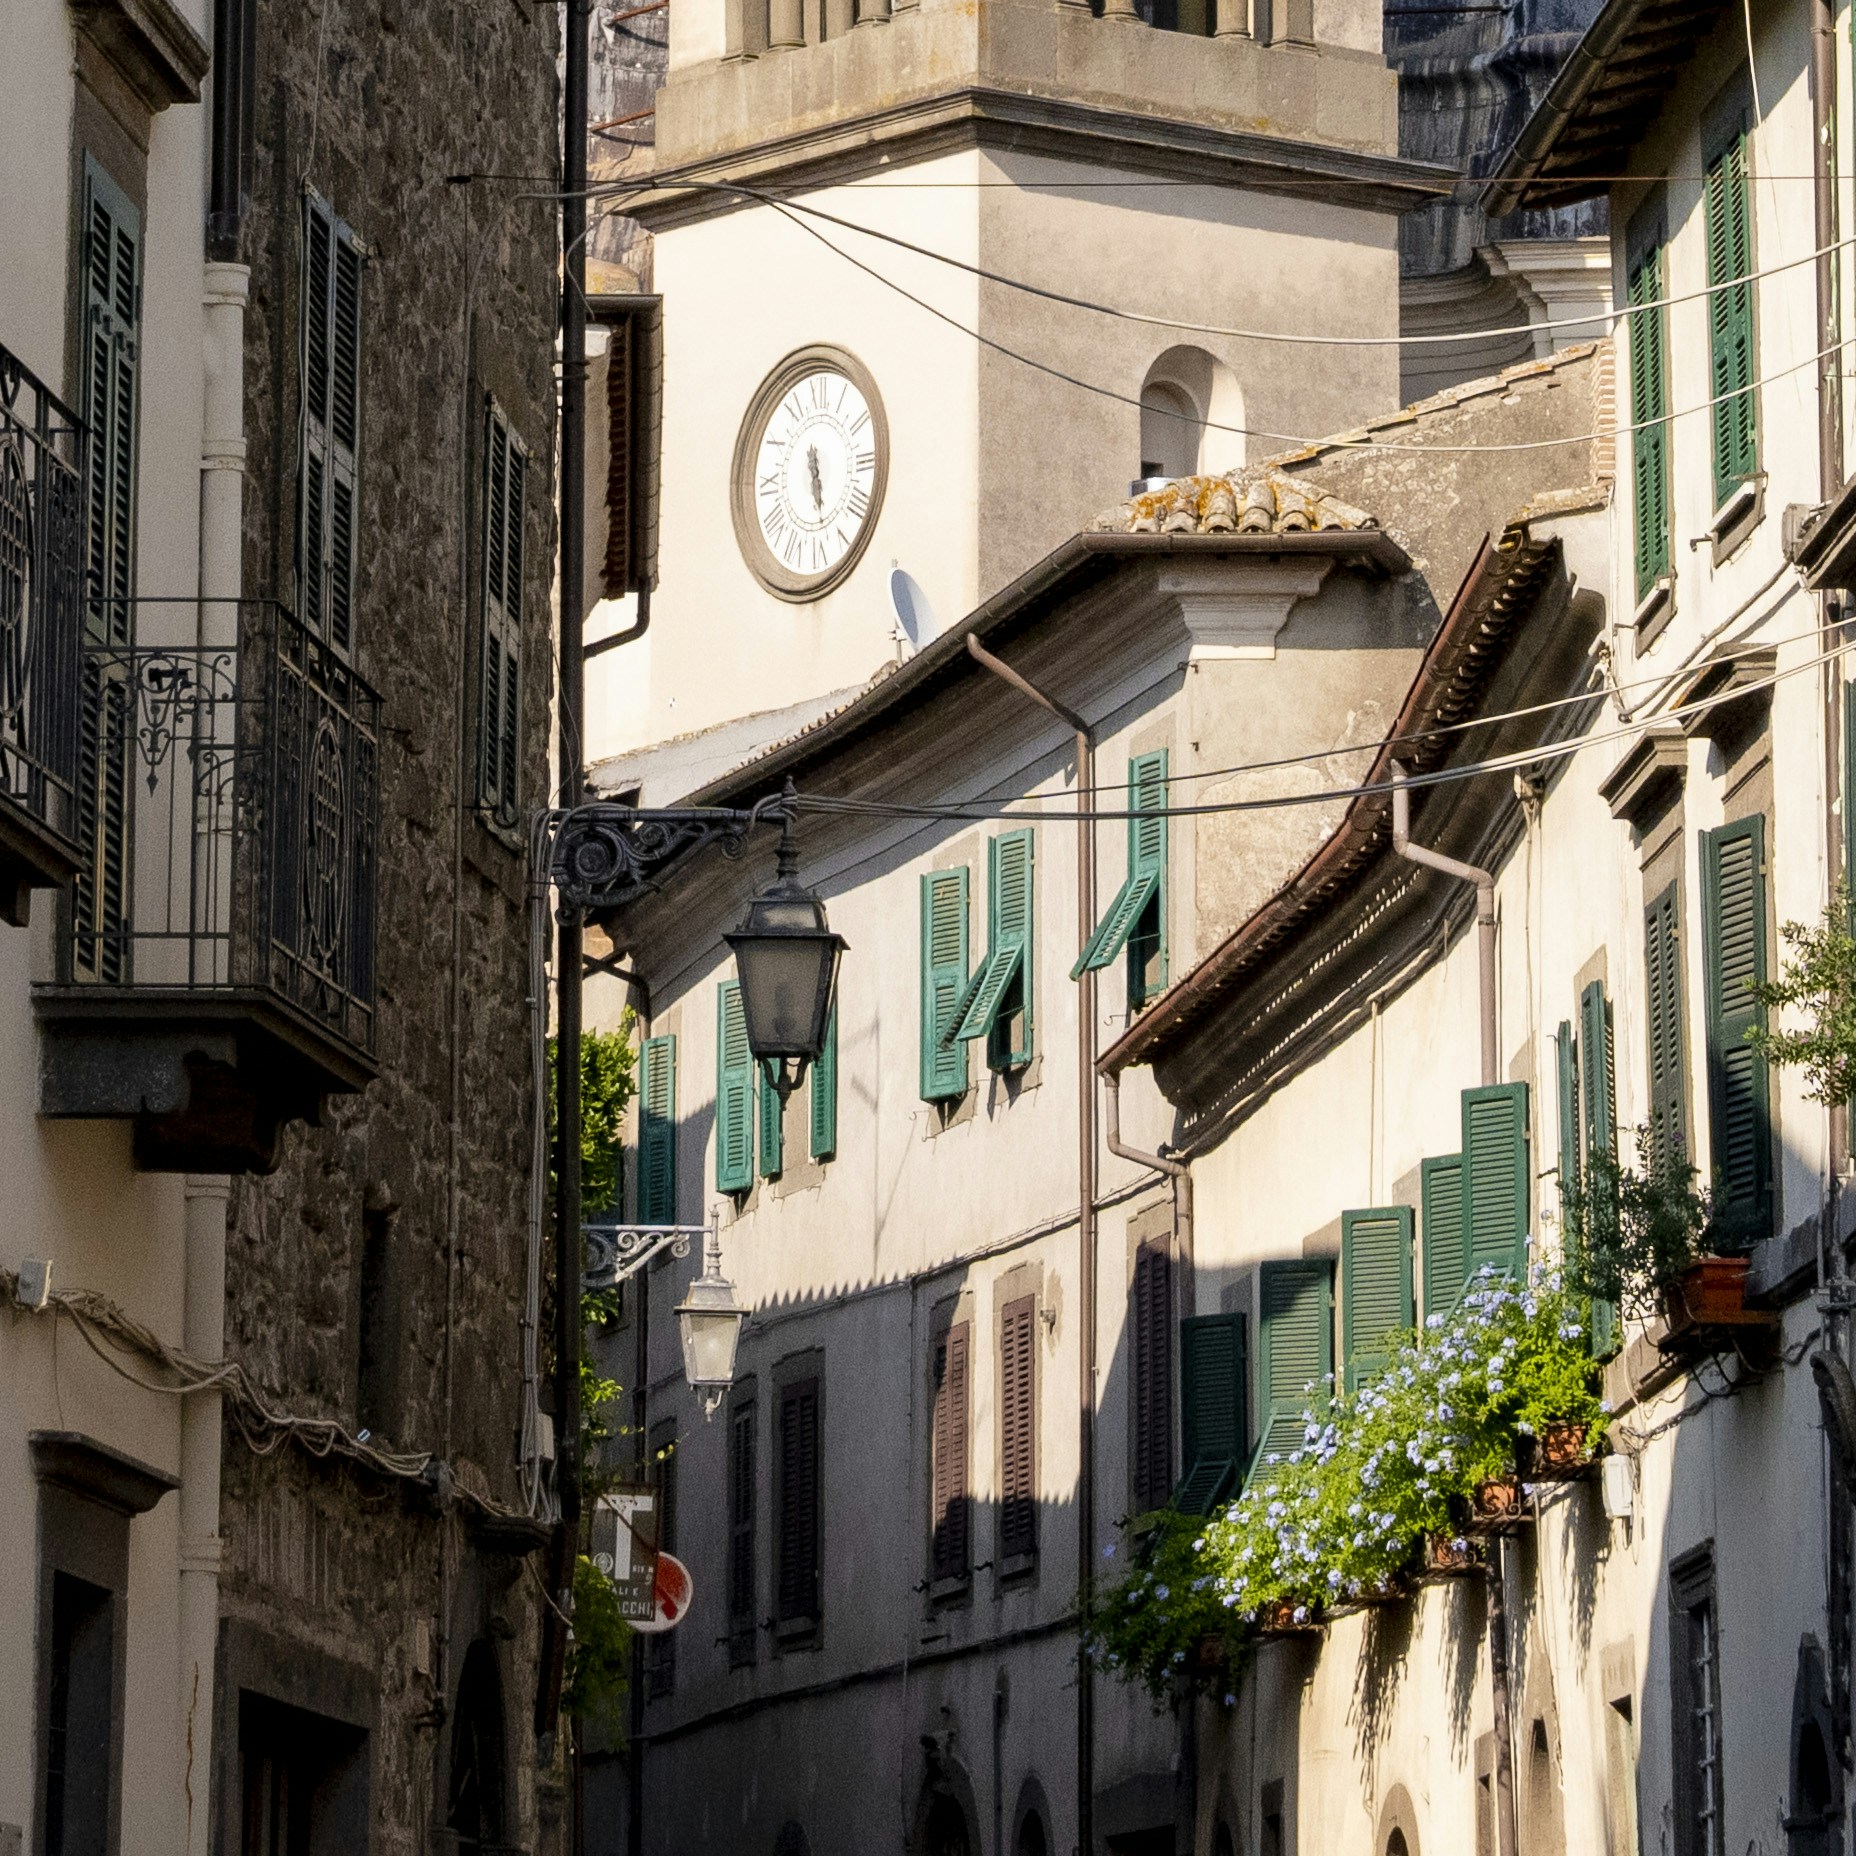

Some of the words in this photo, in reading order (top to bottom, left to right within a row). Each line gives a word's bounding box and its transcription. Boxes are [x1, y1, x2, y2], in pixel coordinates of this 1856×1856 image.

[783, 391, 804, 423] XI
[810, 376, 827, 410] XII
[849, 409, 871, 437] II
[766, 429, 786, 456] X
[855, 451, 874, 473] III
[597, 1494, 653, 1580] T
